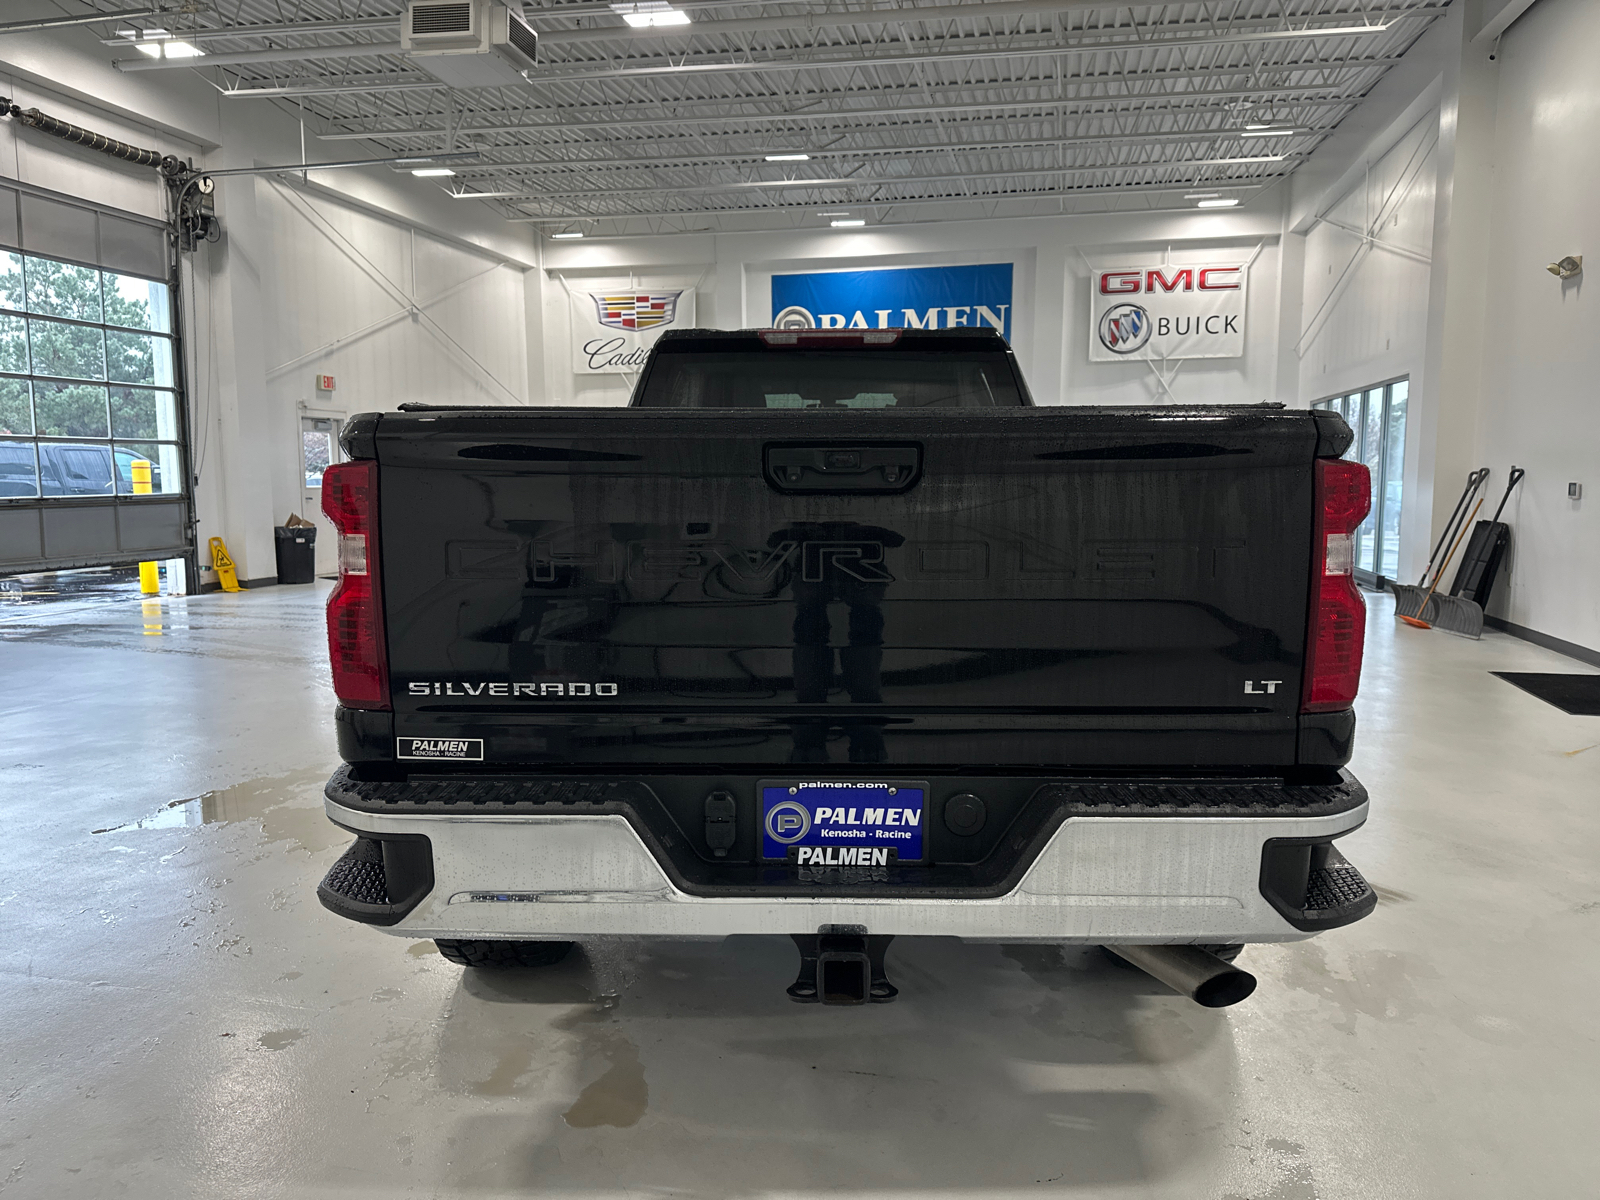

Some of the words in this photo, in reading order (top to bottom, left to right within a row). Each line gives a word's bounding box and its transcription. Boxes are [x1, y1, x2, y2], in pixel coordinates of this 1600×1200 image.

[1099, 265, 1242, 296] GMC
[1158, 315, 1238, 336] BUICK
[444, 539, 1246, 583] CHEVROLET
[408, 682, 618, 696] SILVERADO
[1244, 680, 1283, 694] LT
[411, 740, 468, 751] PALMEN
[798, 781, 888, 789] palmen.com
[814, 807, 921, 826] PALMEN
[821, 829, 866, 838] Kenosha
[875, 829, 912, 839] Racine
[797, 847, 888, 866] PALMEN
